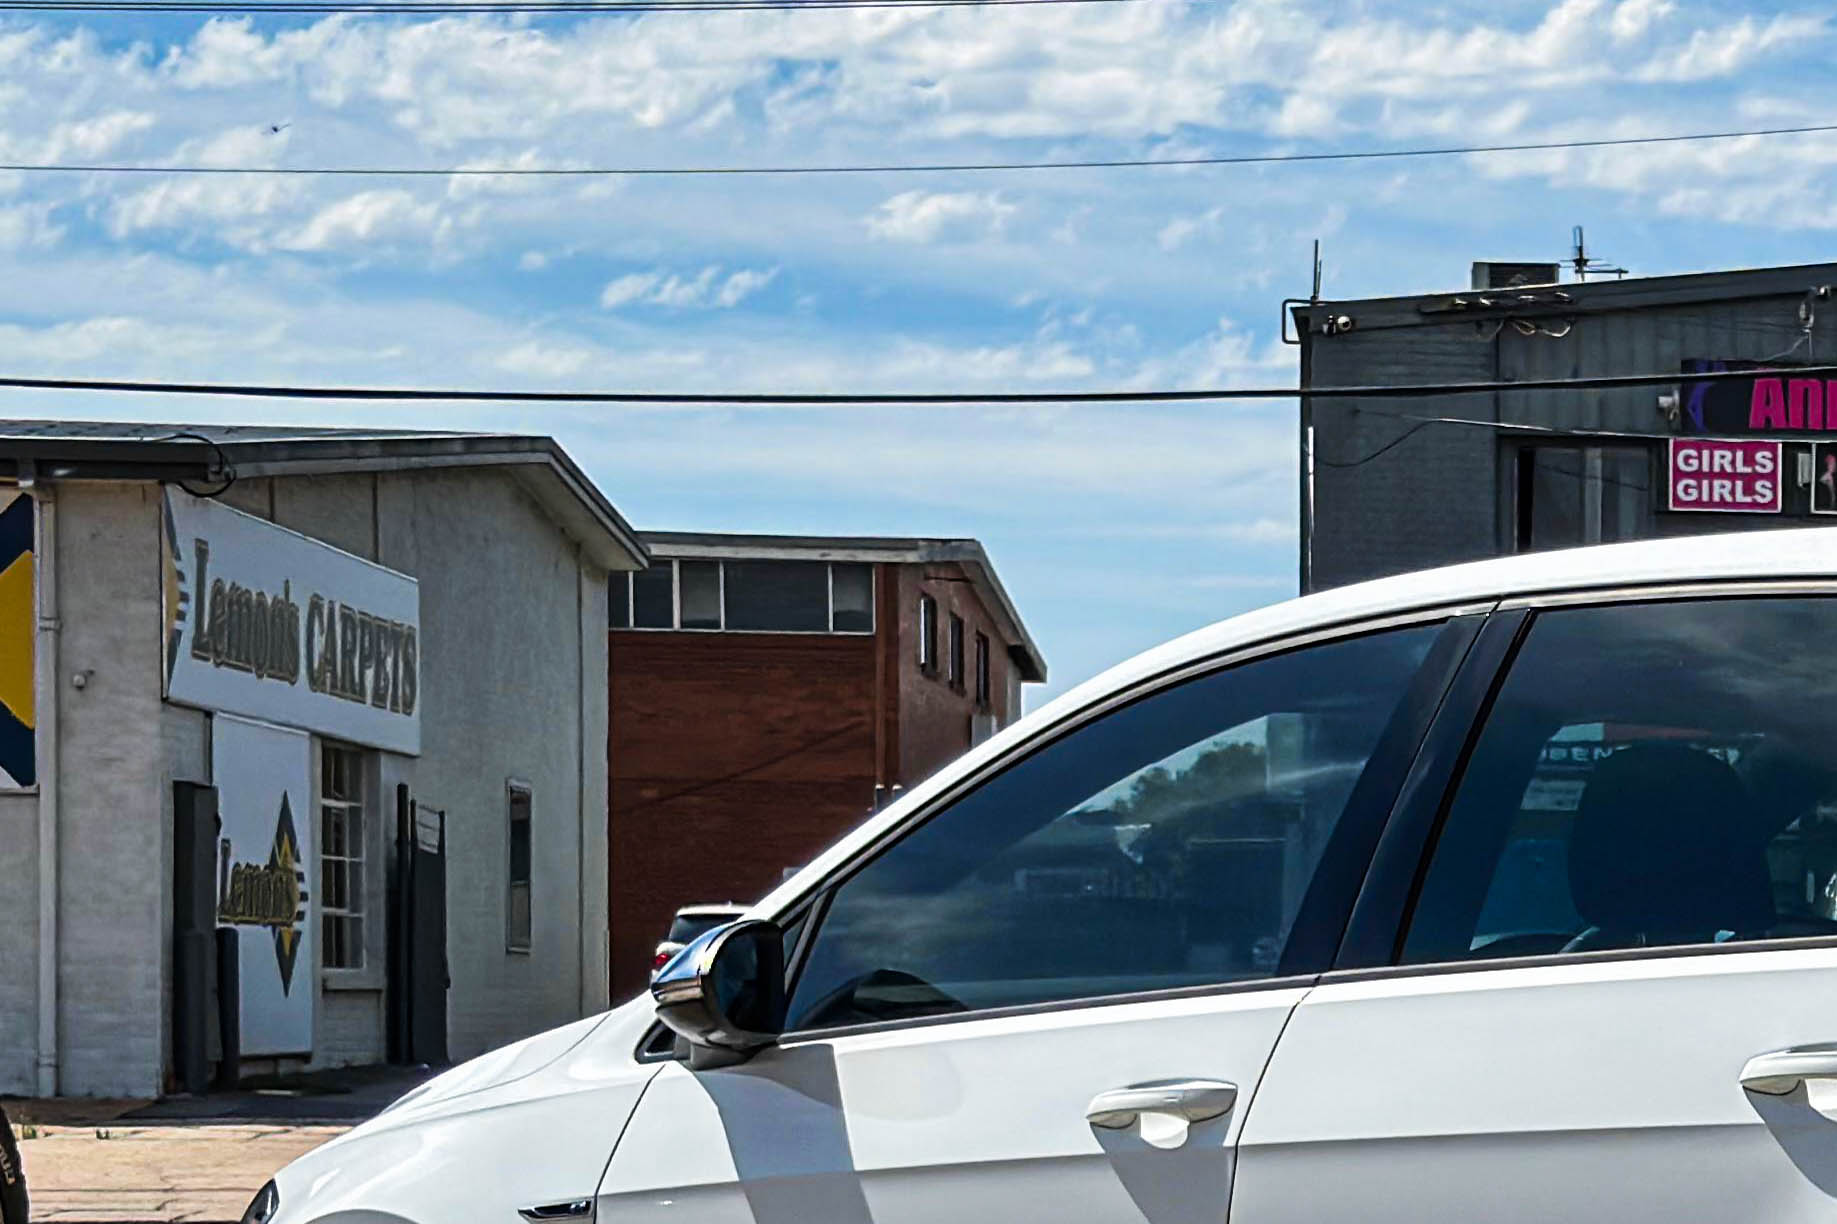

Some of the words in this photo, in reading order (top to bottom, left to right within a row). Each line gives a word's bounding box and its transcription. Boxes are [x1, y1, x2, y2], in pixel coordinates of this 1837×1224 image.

[1676, 449, 1774, 474] GIRLS
[1676, 478, 1774, 503] GIRLS
[305, 592, 417, 716] CARPETS
